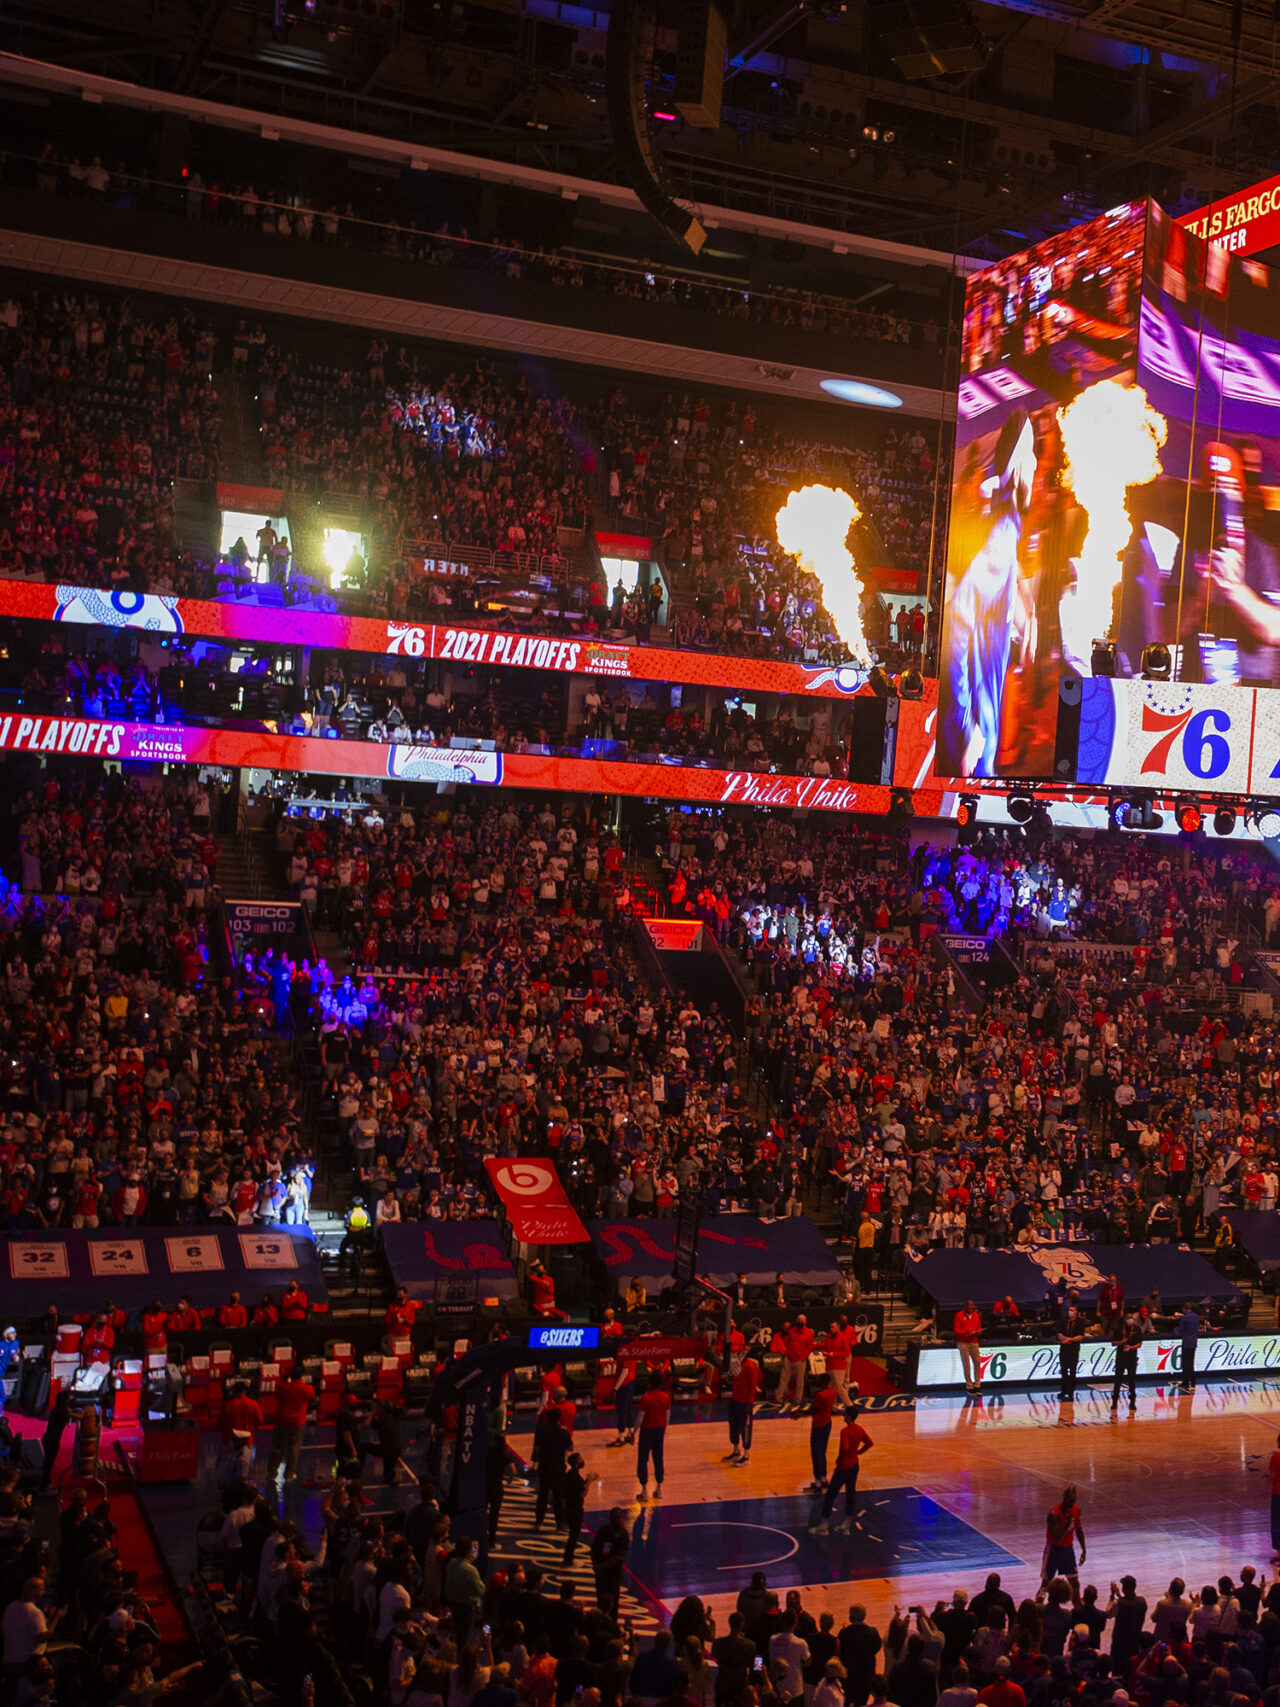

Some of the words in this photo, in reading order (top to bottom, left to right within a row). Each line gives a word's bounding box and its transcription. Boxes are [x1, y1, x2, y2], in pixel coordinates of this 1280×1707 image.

[1184, 213, 1223, 240] LLS
[386, 620, 425, 657] 76
[439, 630, 489, 661] 2021
[489, 635, 582, 671] PLAYOFFS
[591, 658, 628, 669] KINGS
[584, 666, 632, 677] SPORTSBOOK
[13, 717, 126, 755] PLAYOFFS
[1140, 703, 1231, 779] 76
[138, 740, 183, 753] KINGS
[130, 750, 187, 761] SPORTSBOOK
[404, 746, 489, 765] Philadelphia
[720, 771, 793, 802] Phila
[796, 777, 858, 809] Unite
[235, 906, 290, 918] GEICO
[229, 919, 251, 931] 103
[271, 921, 296, 934] 102
[649, 924, 695, 936] GEICO
[944, 939, 986, 950] GEICO
[971, 952, 990, 963] 124
[102, 1250, 134, 1261] 24
[186, 1246, 203, 1258] 6
[255, 1244, 280, 1255] 13
[22, 1251, 55, 1263] 32
[540, 1329, 585, 1346] @SIXERS
[857, 1323, 878, 1344] 76
[1205, 1340, 1261, 1372] Phila
[463, 1403, 476, 1438] NBA
[462, 1442, 473, 1464] TV
